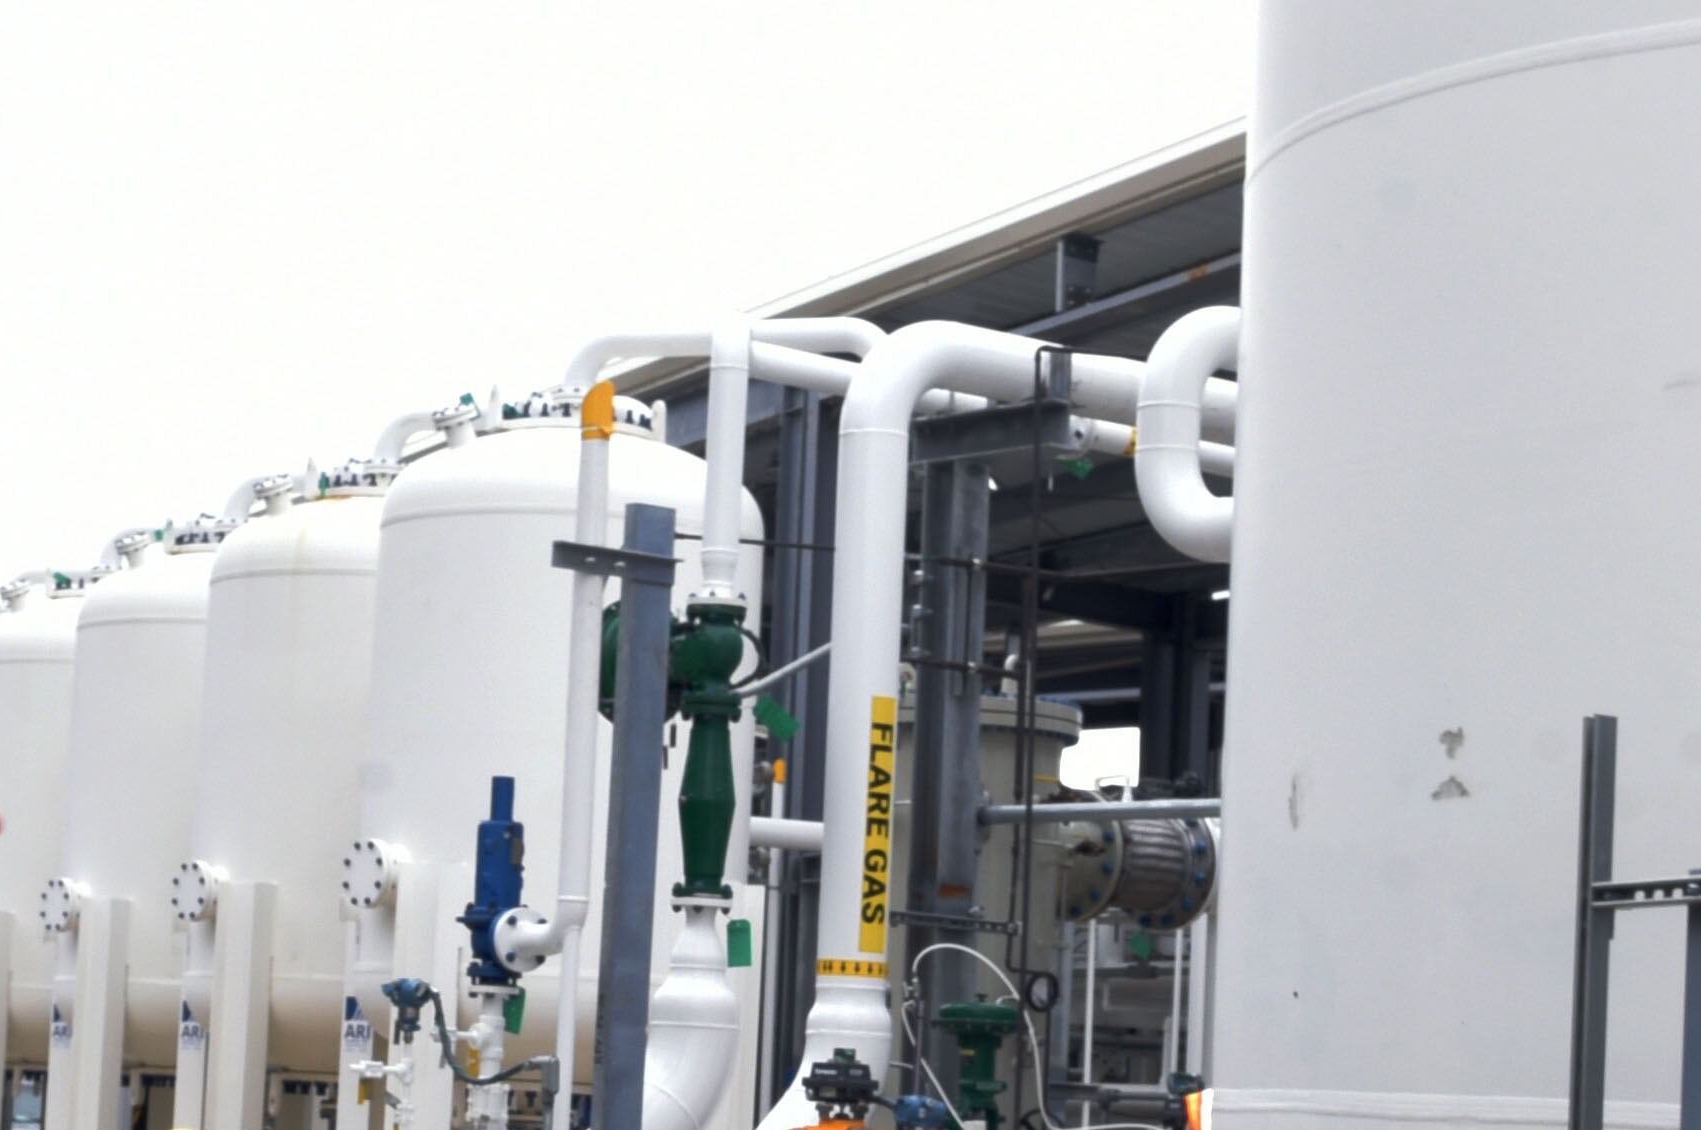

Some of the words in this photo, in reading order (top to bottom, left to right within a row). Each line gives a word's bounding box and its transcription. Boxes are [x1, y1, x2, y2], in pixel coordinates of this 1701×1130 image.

[866, 723, 893, 837] FLARE
[861, 848, 887, 924] GAS
[344, 1024, 371, 1040] ARI
